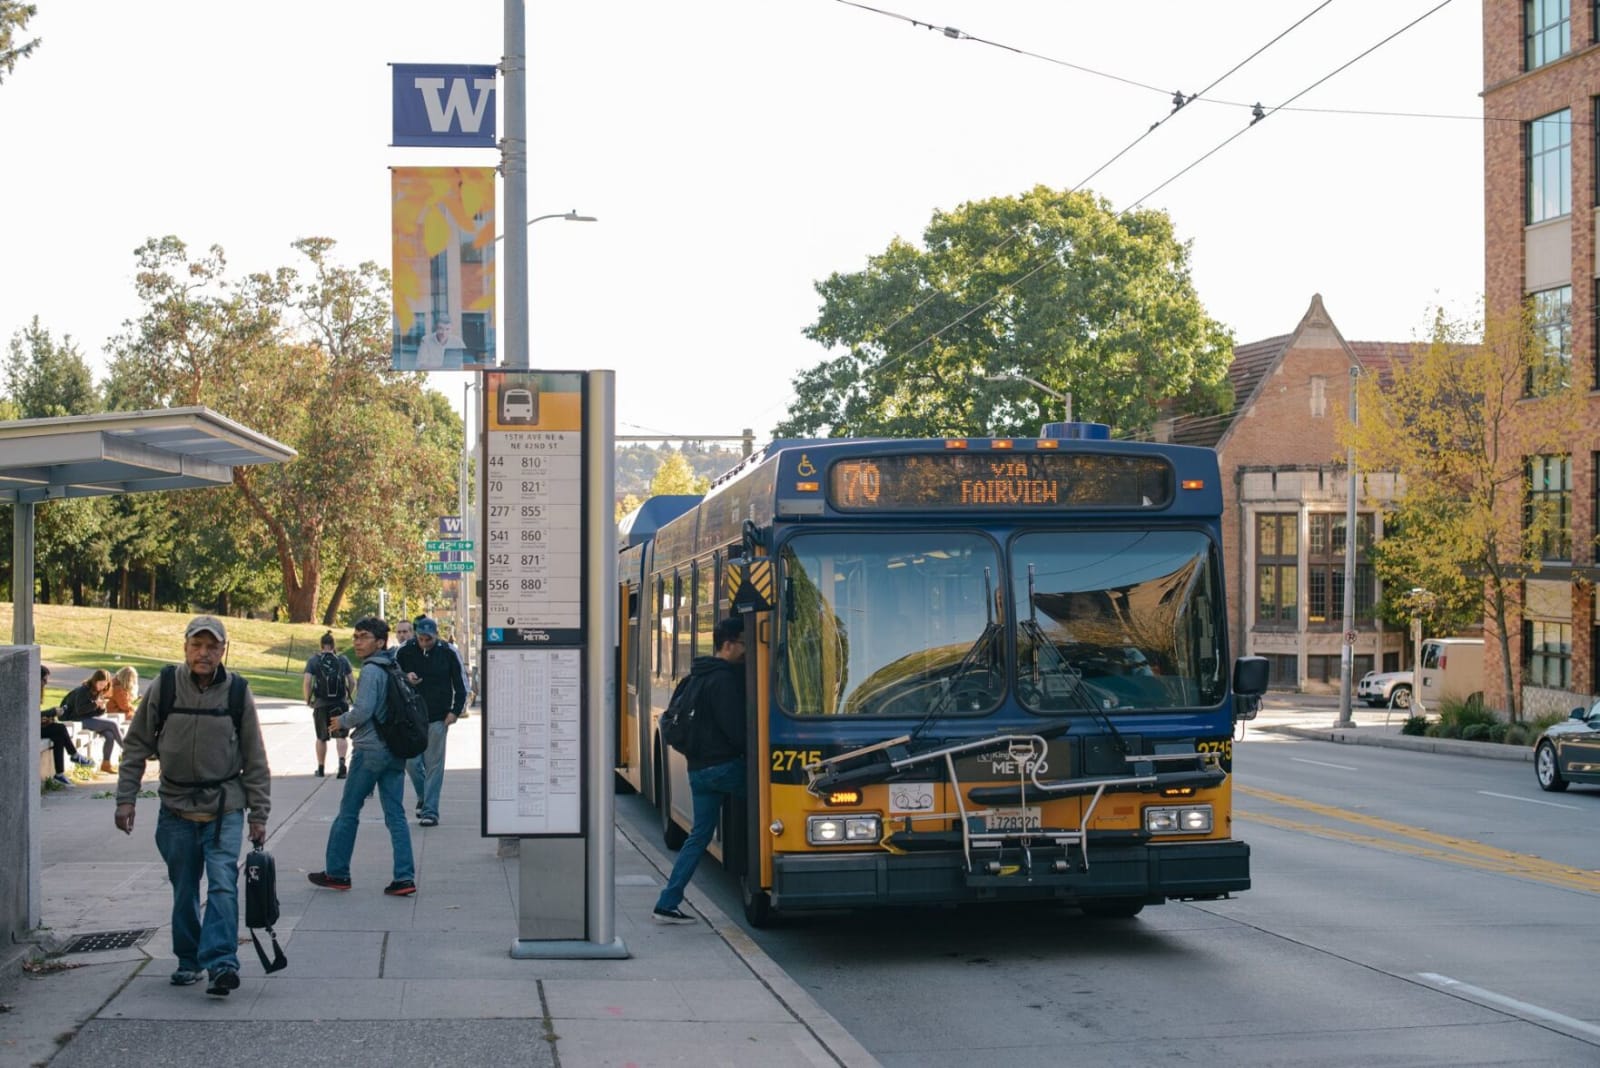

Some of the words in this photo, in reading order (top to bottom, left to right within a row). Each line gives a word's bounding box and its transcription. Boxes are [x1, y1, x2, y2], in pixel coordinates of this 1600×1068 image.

[414, 77, 496, 132] W
[510, 442, 520, 450] NE
[549, 442, 558, 450] ST
[489, 456, 504, 467] 44
[521, 456, 541, 468] 810
[990, 463, 1028, 477] VIA
[489, 481, 503, 492] 70
[521, 481, 540, 493] 821
[847, 464, 880, 502] 70
[961, 480, 1057, 503] FAIRVIEW
[490, 505, 510, 517] 277
[521, 505, 541, 517] 855
[444, 518, 462, 531] W
[490, 530, 509, 541] 541
[521, 530, 542, 541] 860
[489, 554, 510, 565] 542
[520, 554, 540, 566] 871
[488, 579, 509, 590] 556
[520, 579, 542, 590] 880
[772, 750, 822, 772] 2715
[992, 761, 1049, 774] METRO
